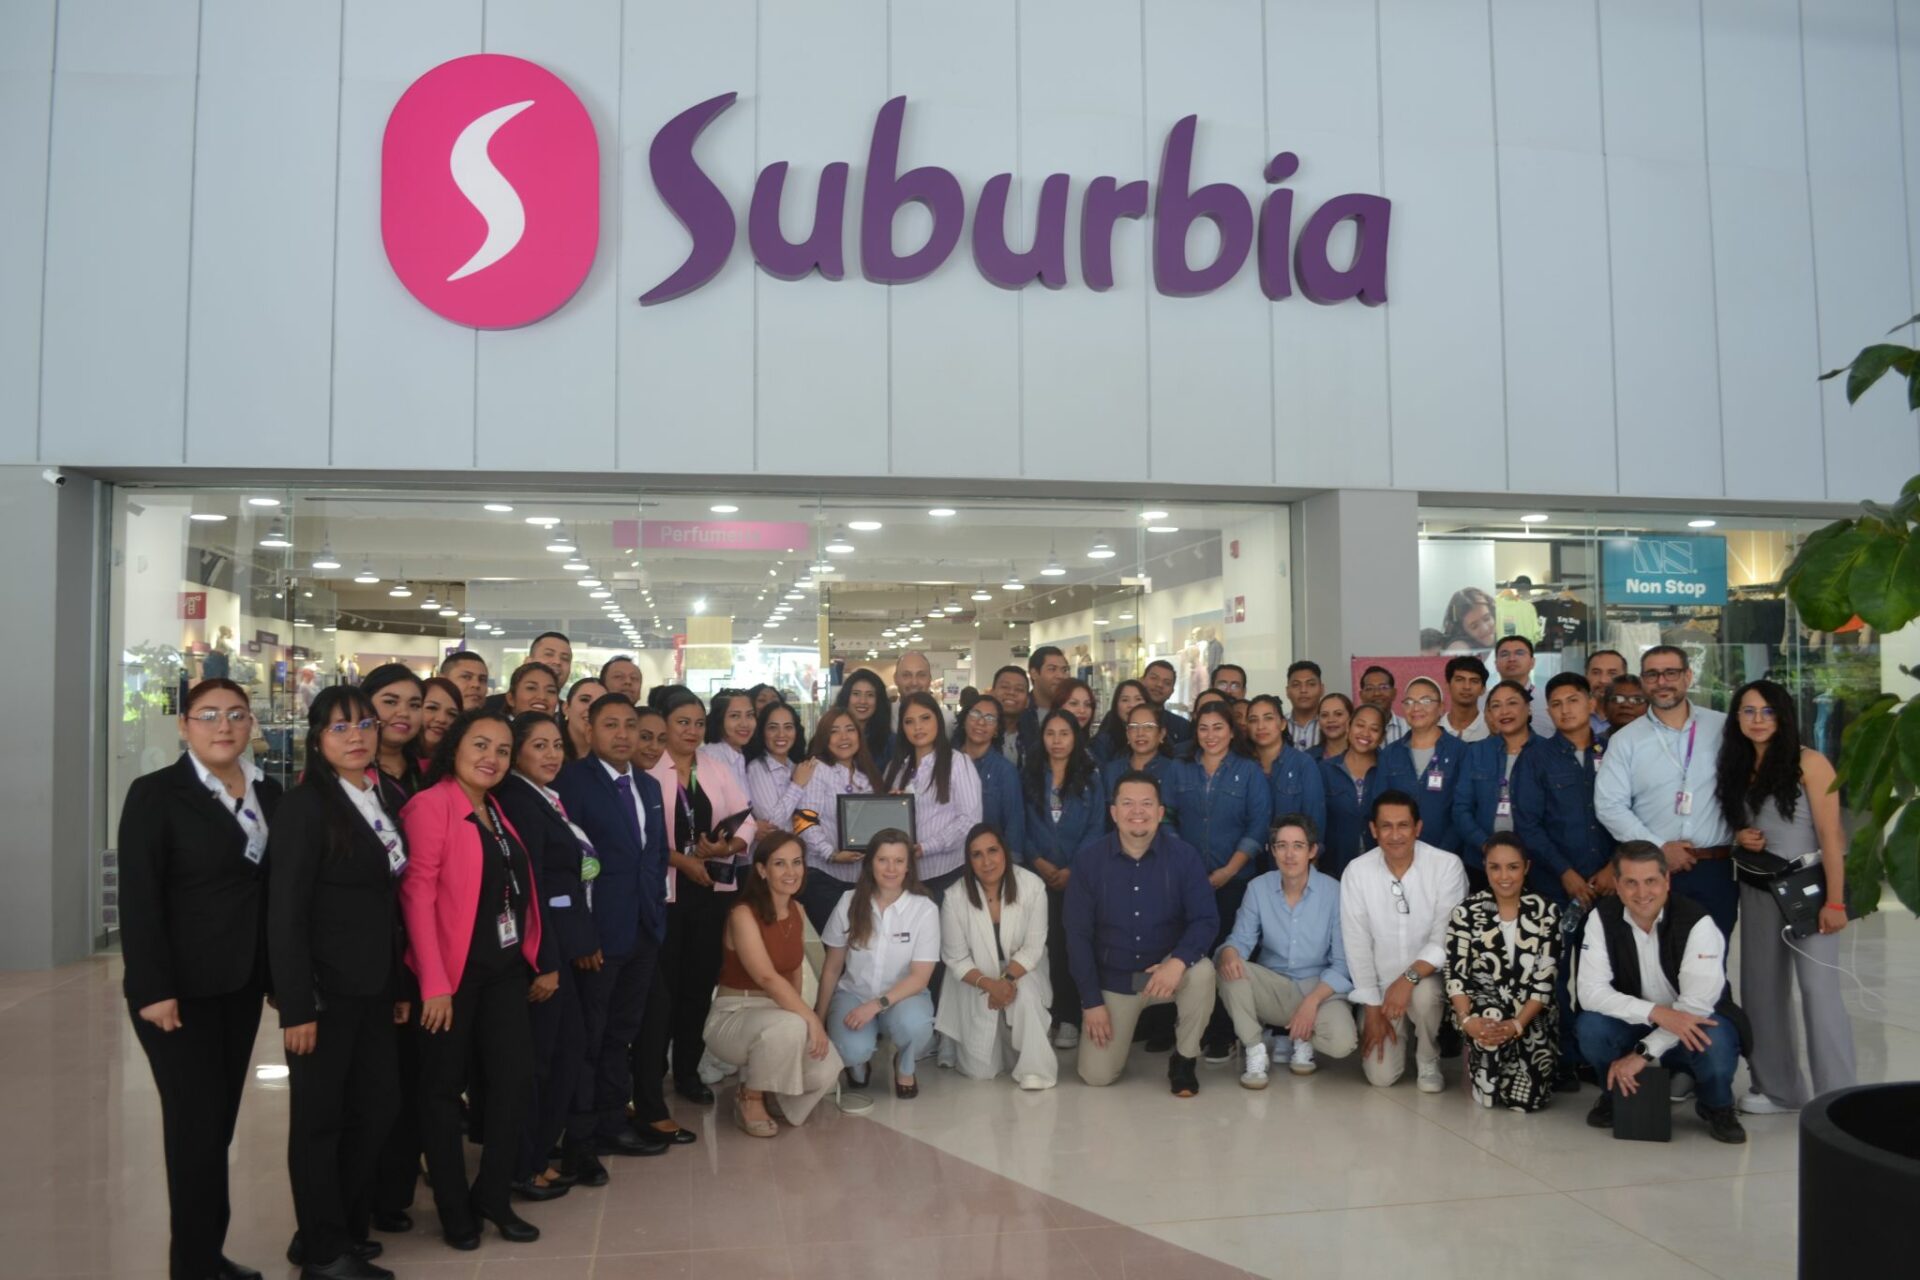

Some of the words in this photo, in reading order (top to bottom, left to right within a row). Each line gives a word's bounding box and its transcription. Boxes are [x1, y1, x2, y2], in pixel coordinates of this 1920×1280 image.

[638, 90, 1392, 306] Suburbia
[1625, 579, 1662, 594] Non
[1664, 579, 1707, 599] Stop
